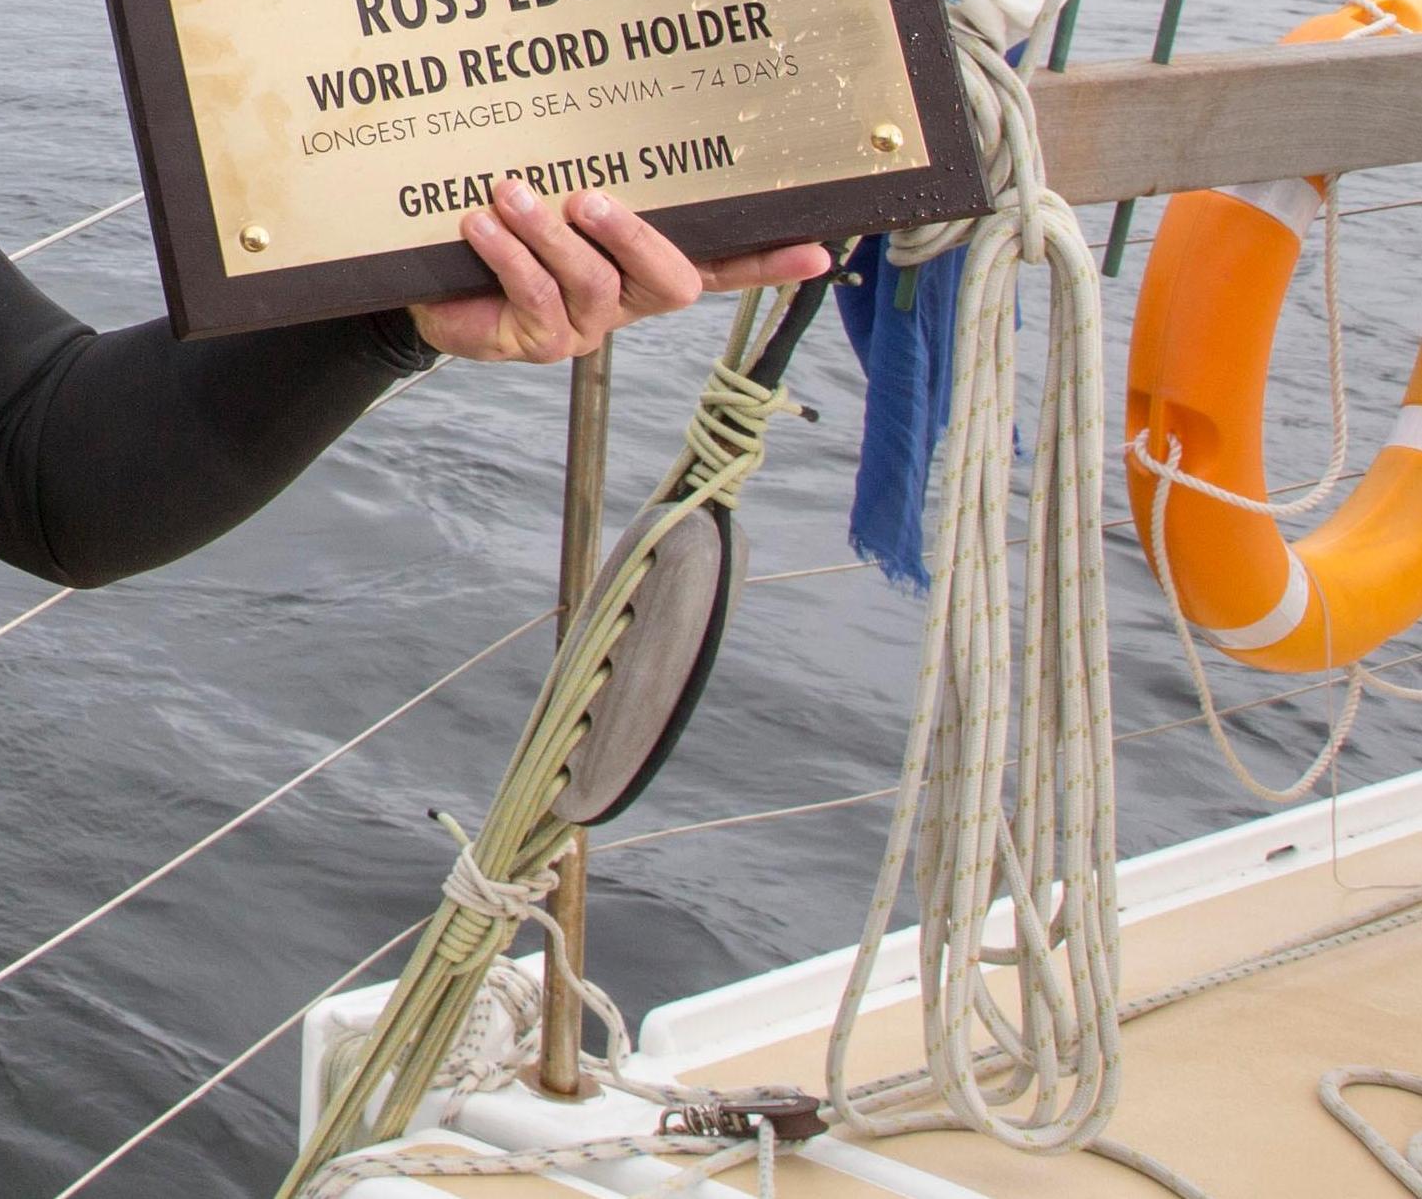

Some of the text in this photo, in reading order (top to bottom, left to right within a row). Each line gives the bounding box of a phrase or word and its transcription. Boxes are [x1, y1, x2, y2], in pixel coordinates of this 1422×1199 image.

[301, 116, 417, 156] LONGEST
[426, 99, 523, 136] STAGED
[531, 91, 581, 118] SEA
[587, 77, 664, 109] SWIM
[691, 67, 726, 92] 74
[733, 54, 800, 86] DAYS
[306, 1, 773, 112] WORLD RECORD HOLDER
[398, 171, 495, 218] GREAT
[638, 134, 735, 180] SWIM
